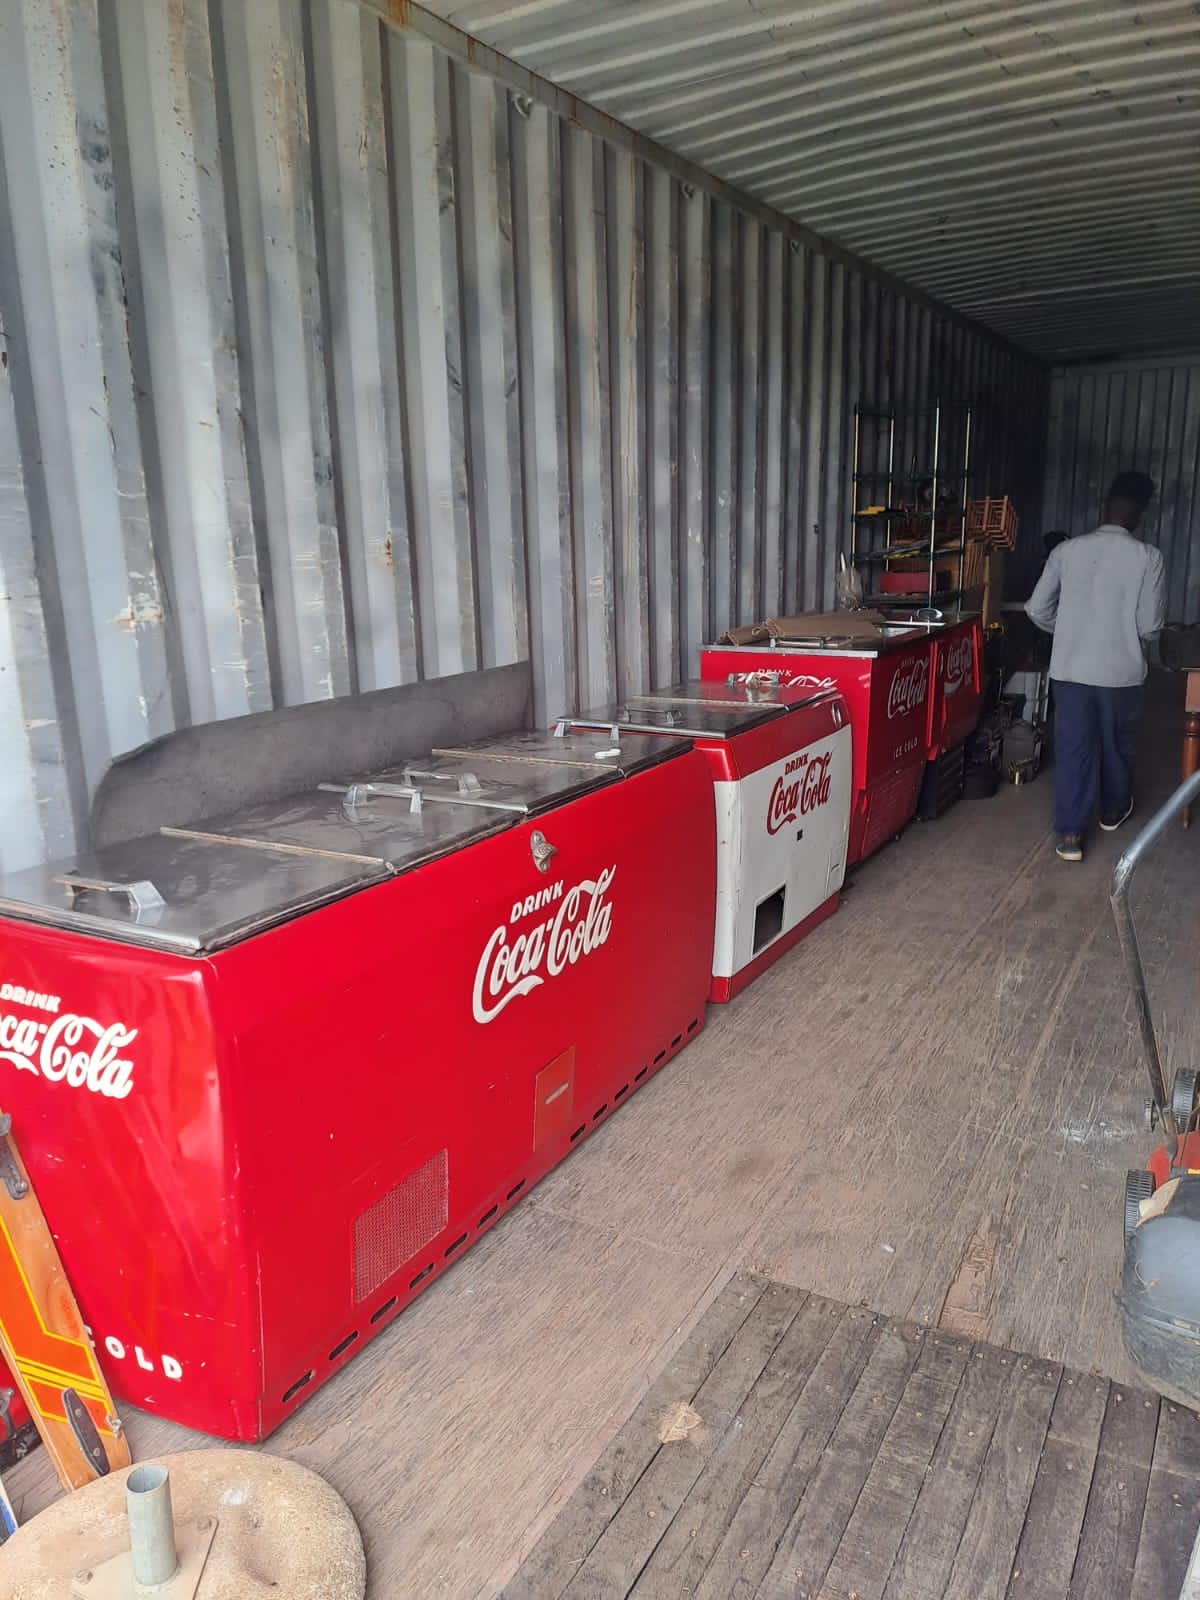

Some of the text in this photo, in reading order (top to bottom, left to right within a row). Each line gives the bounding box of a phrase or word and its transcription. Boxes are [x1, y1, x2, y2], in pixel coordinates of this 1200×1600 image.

[785, 753, 809, 776] DRINK
[767, 751, 832, 836] Coca-Cola
[510, 880, 564, 924] DRINK
[472, 864, 616, 1024] Coca-Cola
[0, 983, 62, 1013] DRINK
